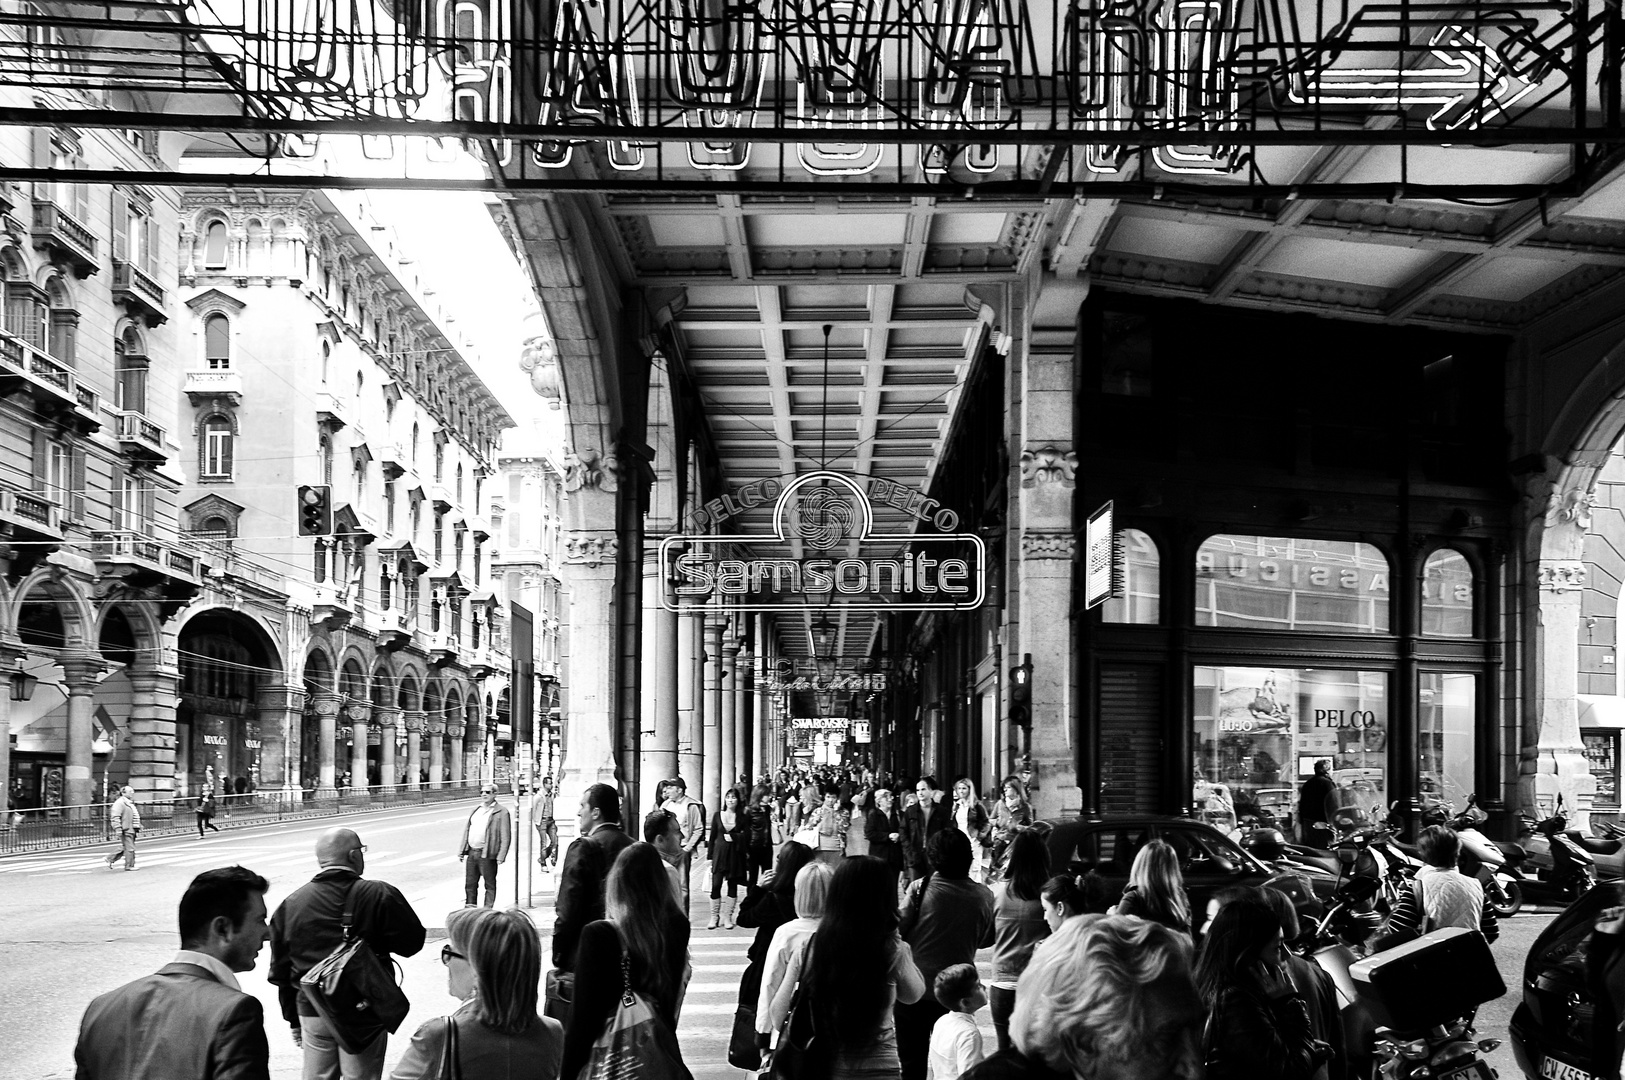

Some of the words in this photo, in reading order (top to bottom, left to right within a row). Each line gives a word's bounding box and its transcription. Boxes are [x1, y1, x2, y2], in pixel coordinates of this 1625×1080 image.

[690, 479, 782, 532] PELCO
[868, 477, 959, 532] PELCO
[675, 550, 969, 594] Samsonite
[792, 718, 848, 729] SWAROVSKI
[1314, 709, 1375, 729] PELCO
